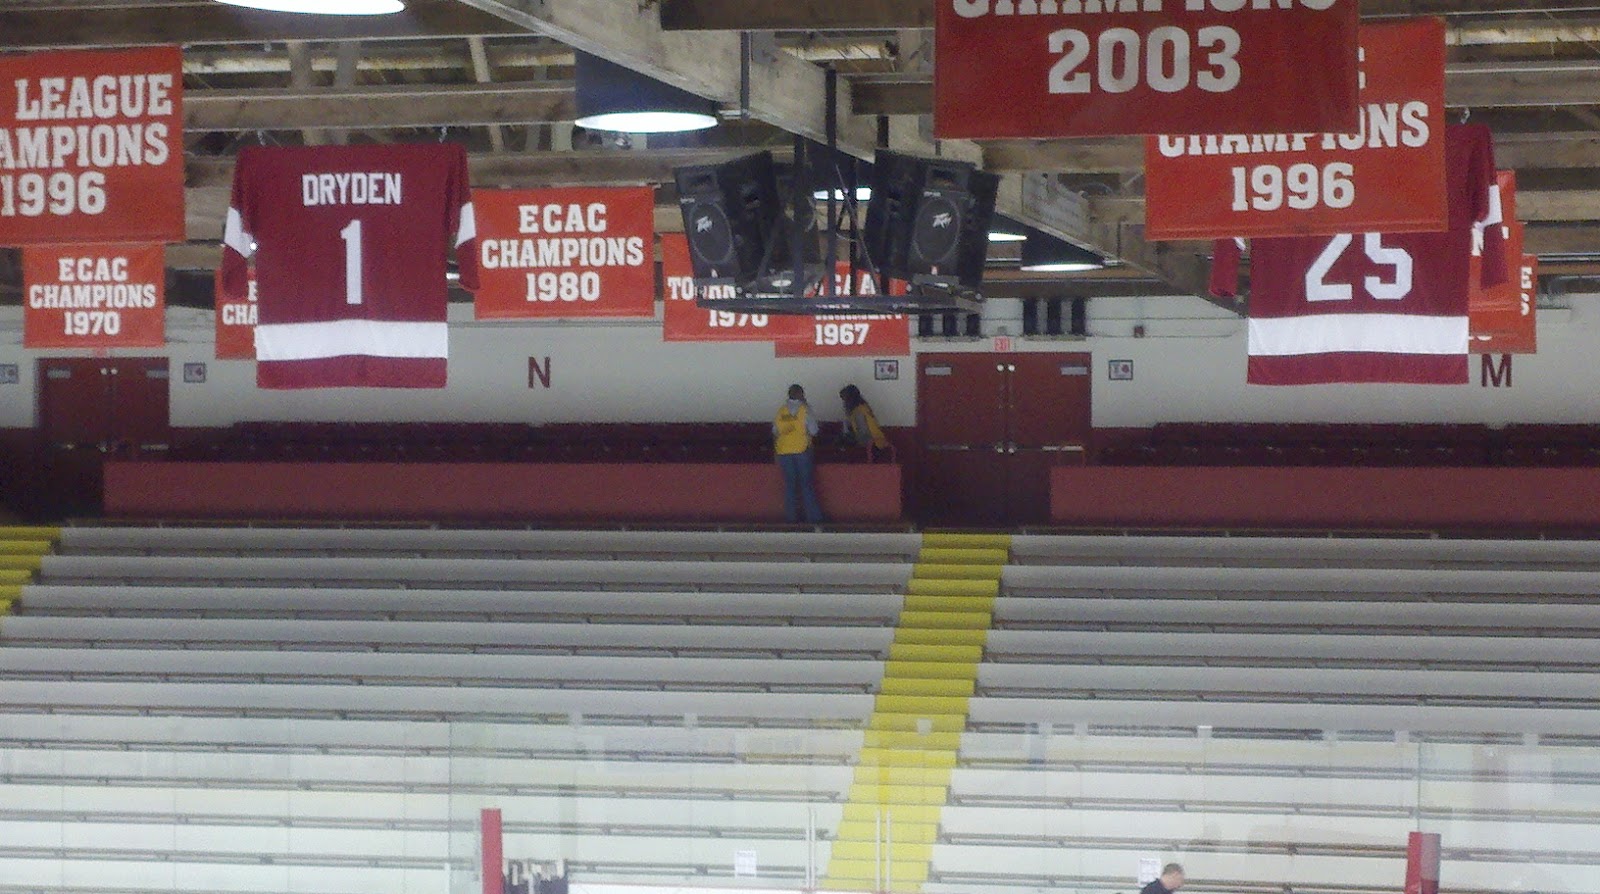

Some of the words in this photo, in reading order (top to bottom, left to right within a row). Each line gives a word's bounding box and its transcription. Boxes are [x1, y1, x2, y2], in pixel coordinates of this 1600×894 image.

[1048, 26, 1242, 94] 2003
[14, 73, 173, 121] LEAGUE
[0, 171, 107, 216] 1996
[302, 172, 402, 207] DRYDEN
[1231, 162, 1356, 212] 1996
[519, 203, 608, 234] ECAC
[58, 257, 129, 282] ECAC
[339, 219, 363, 305] 1
[481, 237, 645, 269] CHAMPIONS
[28, 284, 157, 309] CHAMPIONS
[525, 271, 601, 302] 1980
[63, 312, 120, 335] 1970
[815, 323, 870, 346] 1967
[527, 356, 552, 389] N
[1481, 353, 1512, 387] M
